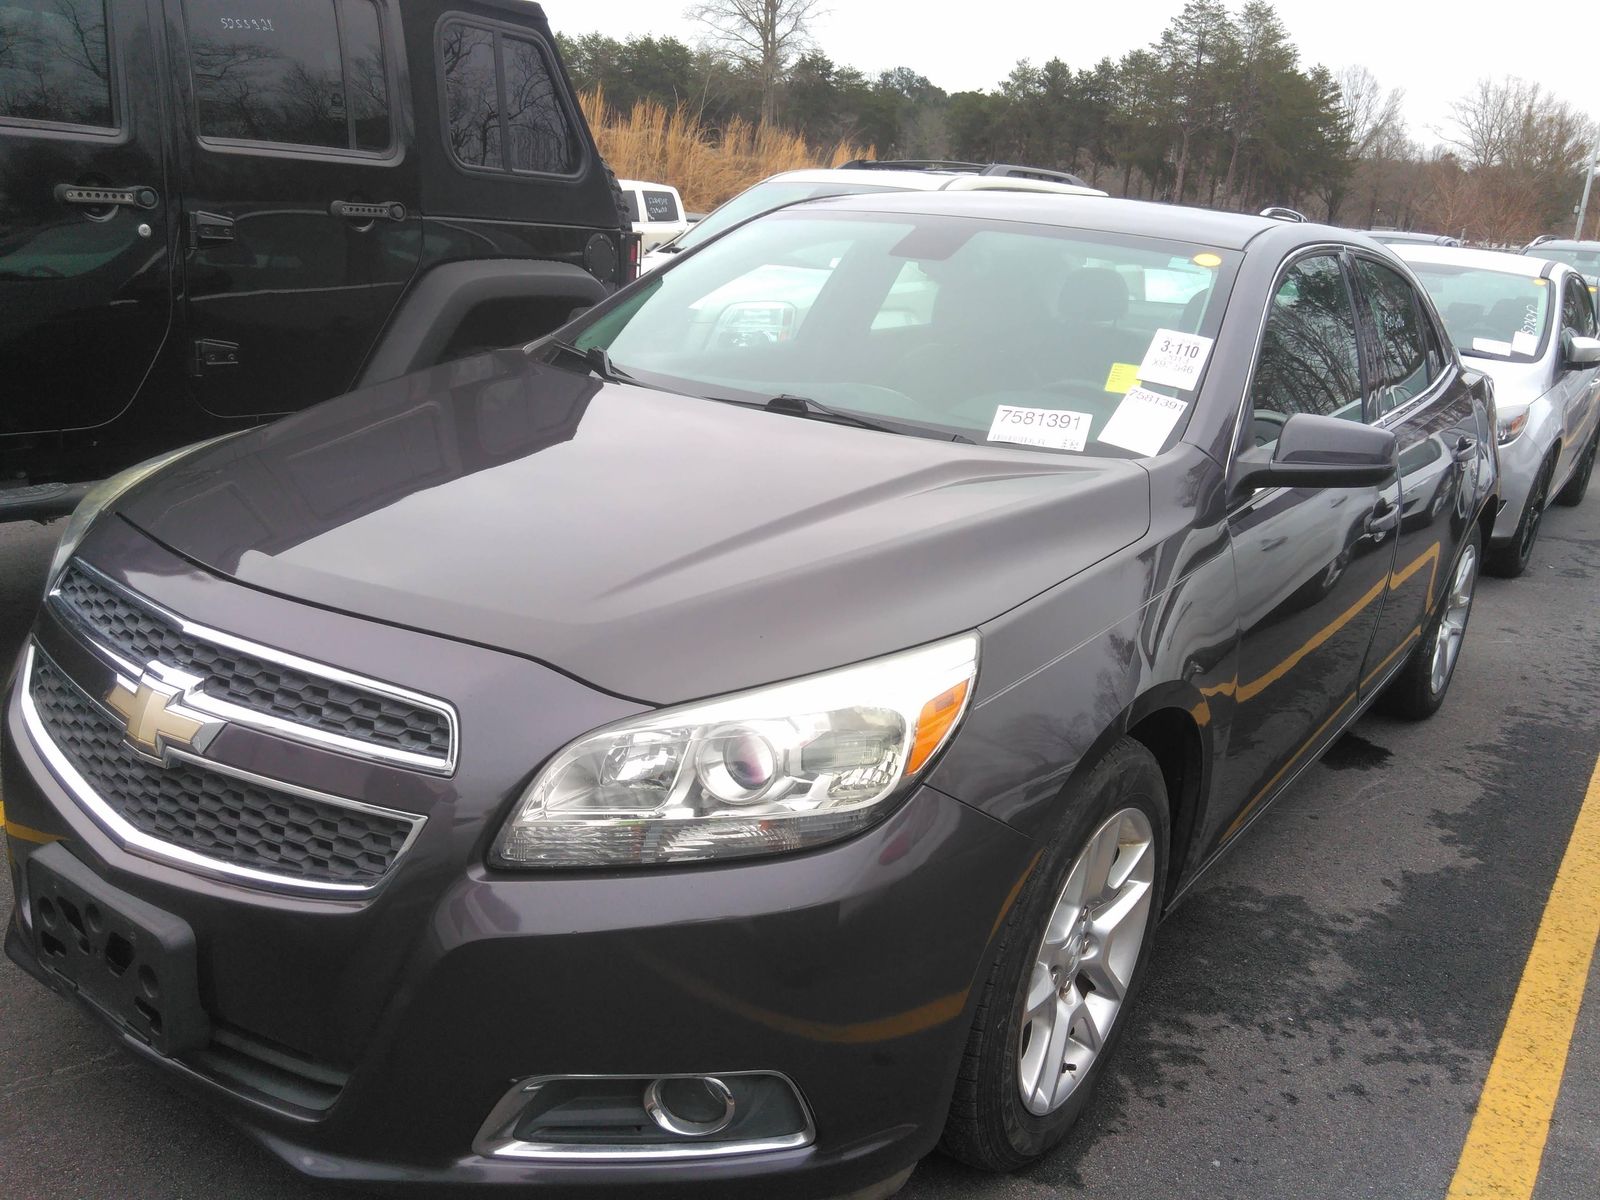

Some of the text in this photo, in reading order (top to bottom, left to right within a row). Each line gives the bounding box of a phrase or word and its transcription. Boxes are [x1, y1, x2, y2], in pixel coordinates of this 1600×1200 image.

[1160, 340, 1200, 359] 3:110
[1129, 388, 1185, 412] 7581391
[1000, 409, 1081, 431] 7581391
